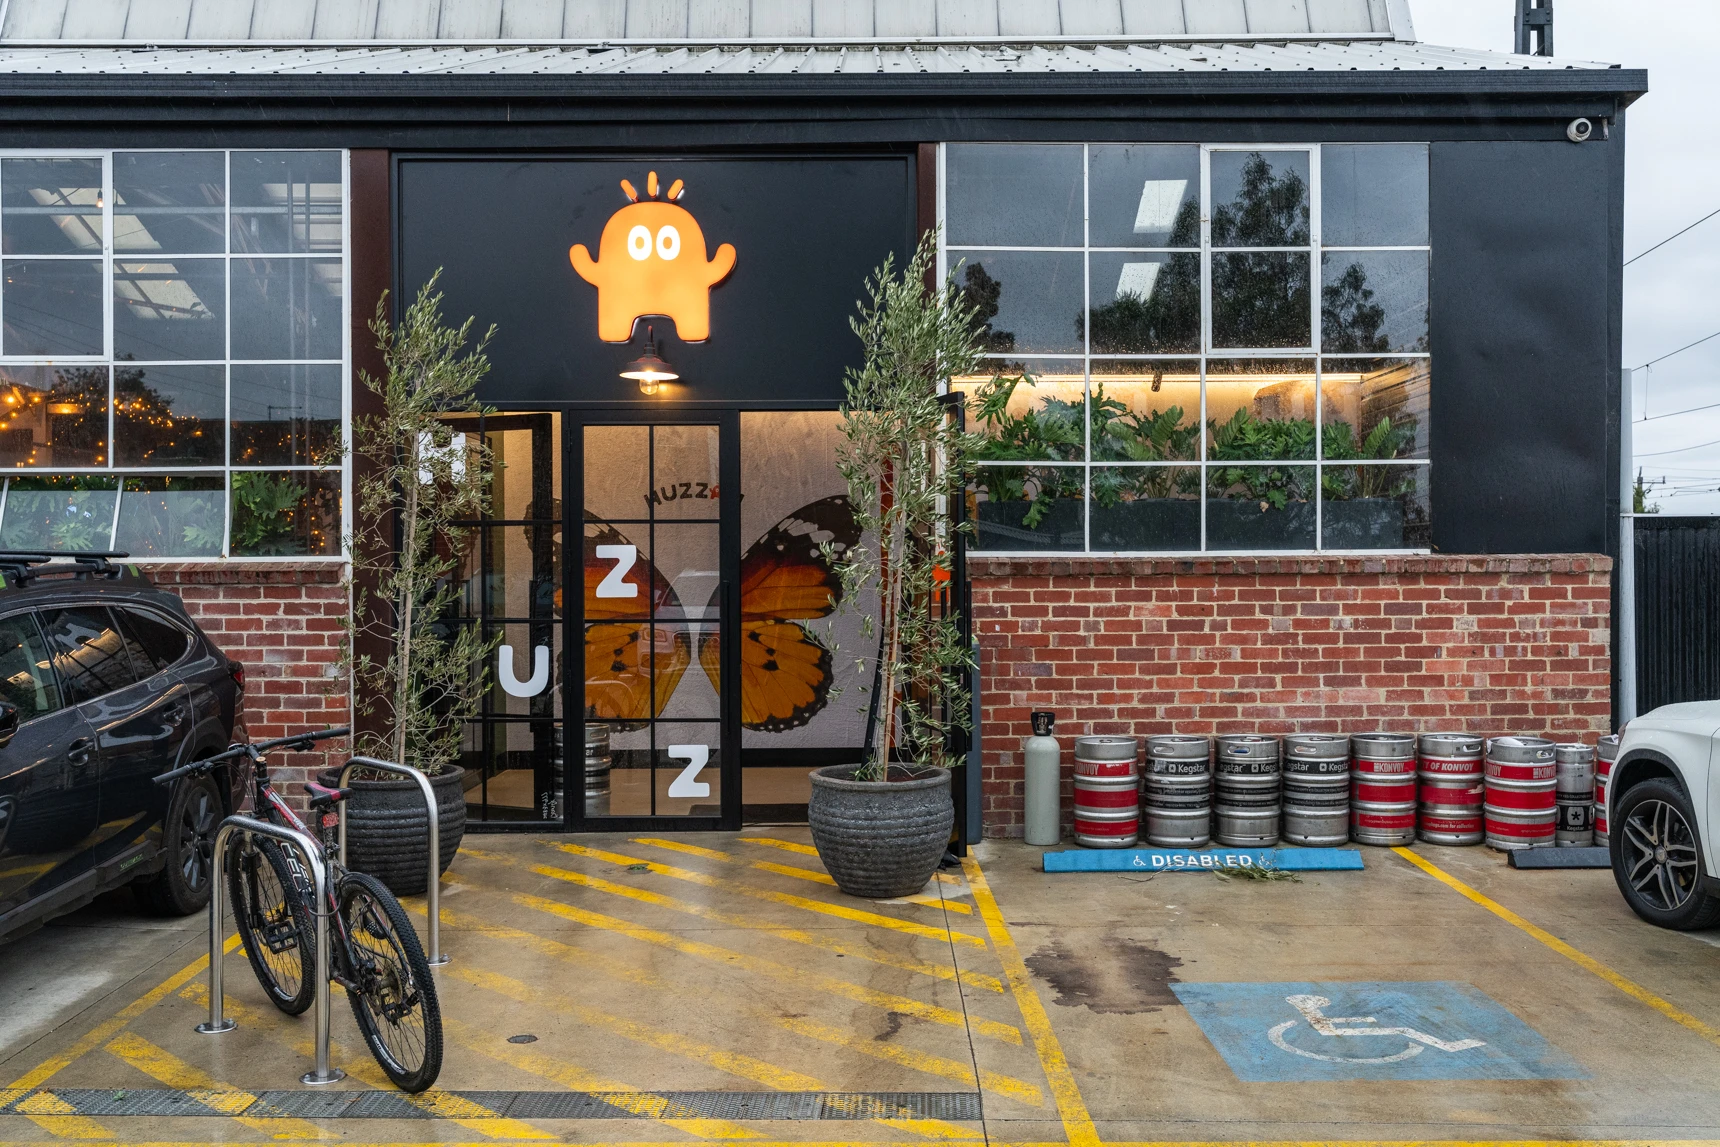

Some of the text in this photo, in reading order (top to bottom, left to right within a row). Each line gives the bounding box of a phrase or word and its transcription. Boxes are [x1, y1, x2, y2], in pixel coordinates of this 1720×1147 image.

[595, 544, 639, 598] Z
[498, 644, 550, 698] U
[667, 744, 711, 798] Z
[1178, 763, 1205, 775] Kegstar
[1379, 762, 1405, 773] KONVOY
[1430, 762, 1441, 770] OF
[1441, 763, 1475, 772] KONVOY
[1151, 854, 1252, 867] DISABLED
